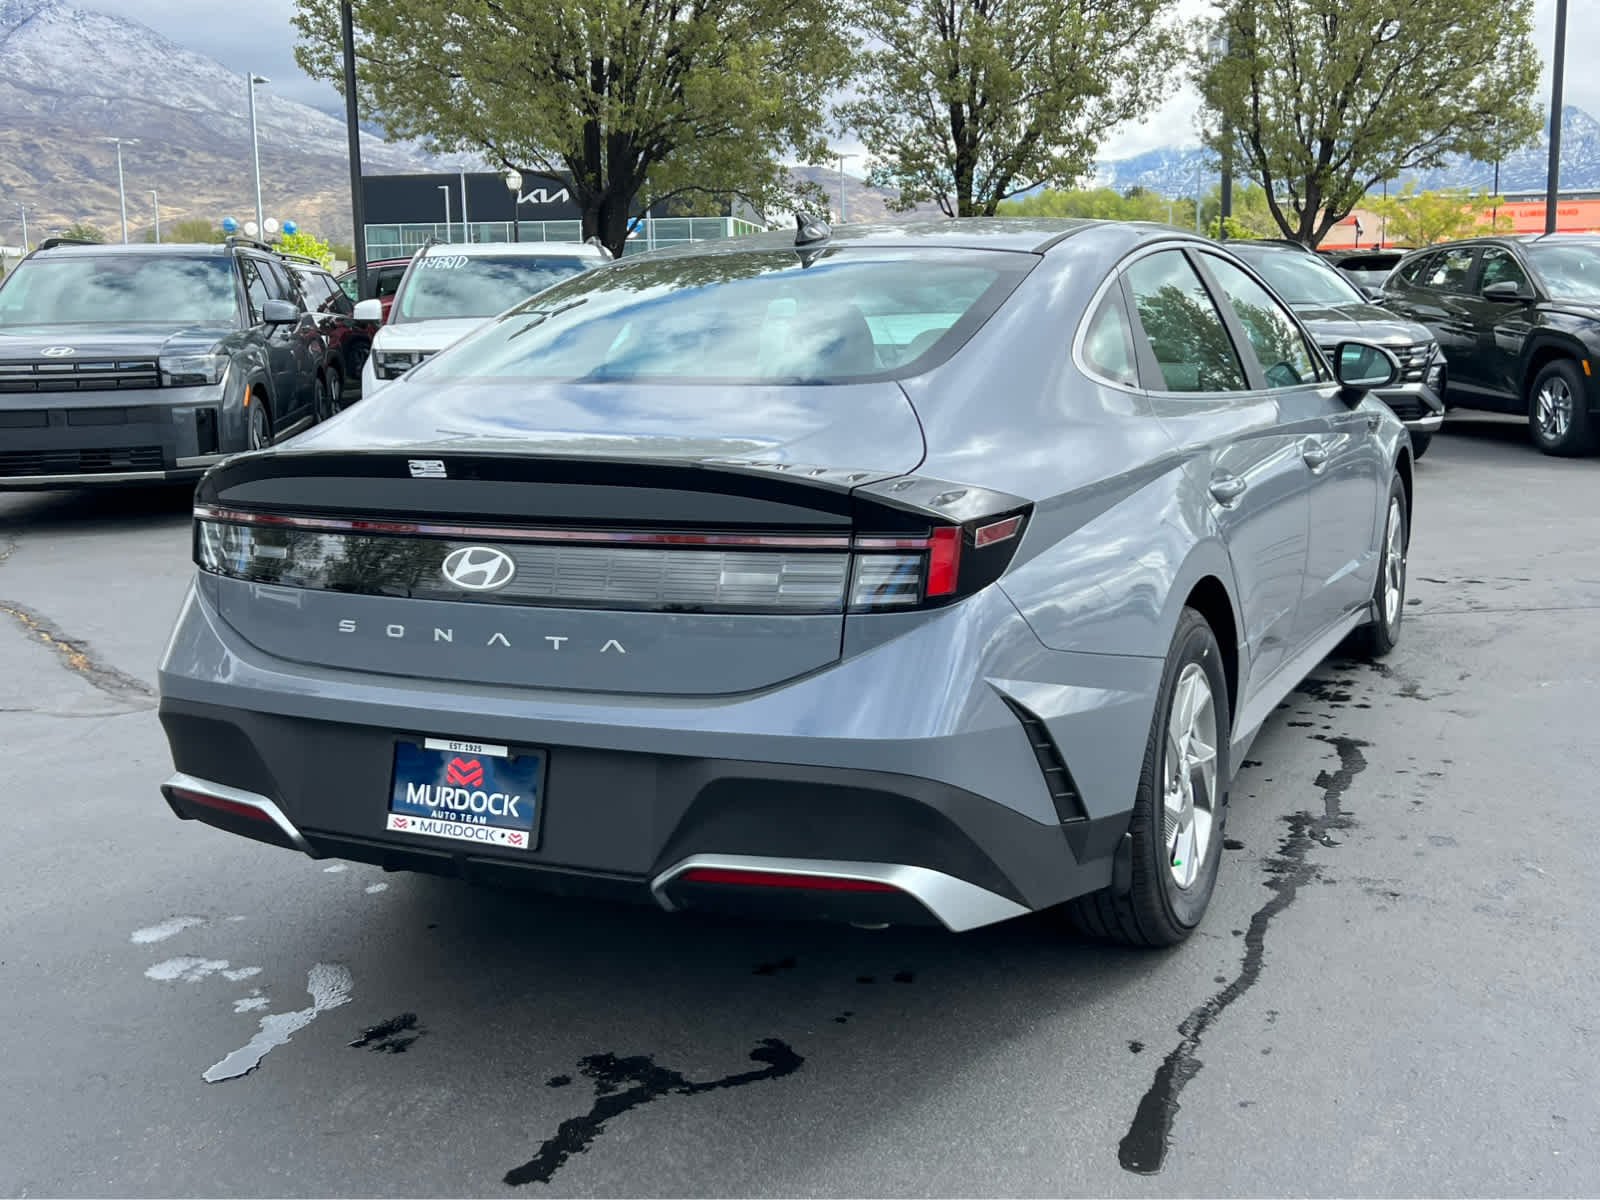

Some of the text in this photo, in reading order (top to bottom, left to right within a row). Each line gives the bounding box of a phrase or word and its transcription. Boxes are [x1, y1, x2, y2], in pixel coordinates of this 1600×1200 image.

[517, 188, 570, 204] KIA
[416, 255, 469, 269] HYBRID
[338, 619, 626, 654] SONATA
[449, 742, 482, 752] EST. 1925
[406, 782, 521, 817] MURDOCK
[431, 810, 487, 825] AUTO TEAM
[419, 820, 497, 841] MURDOCK
